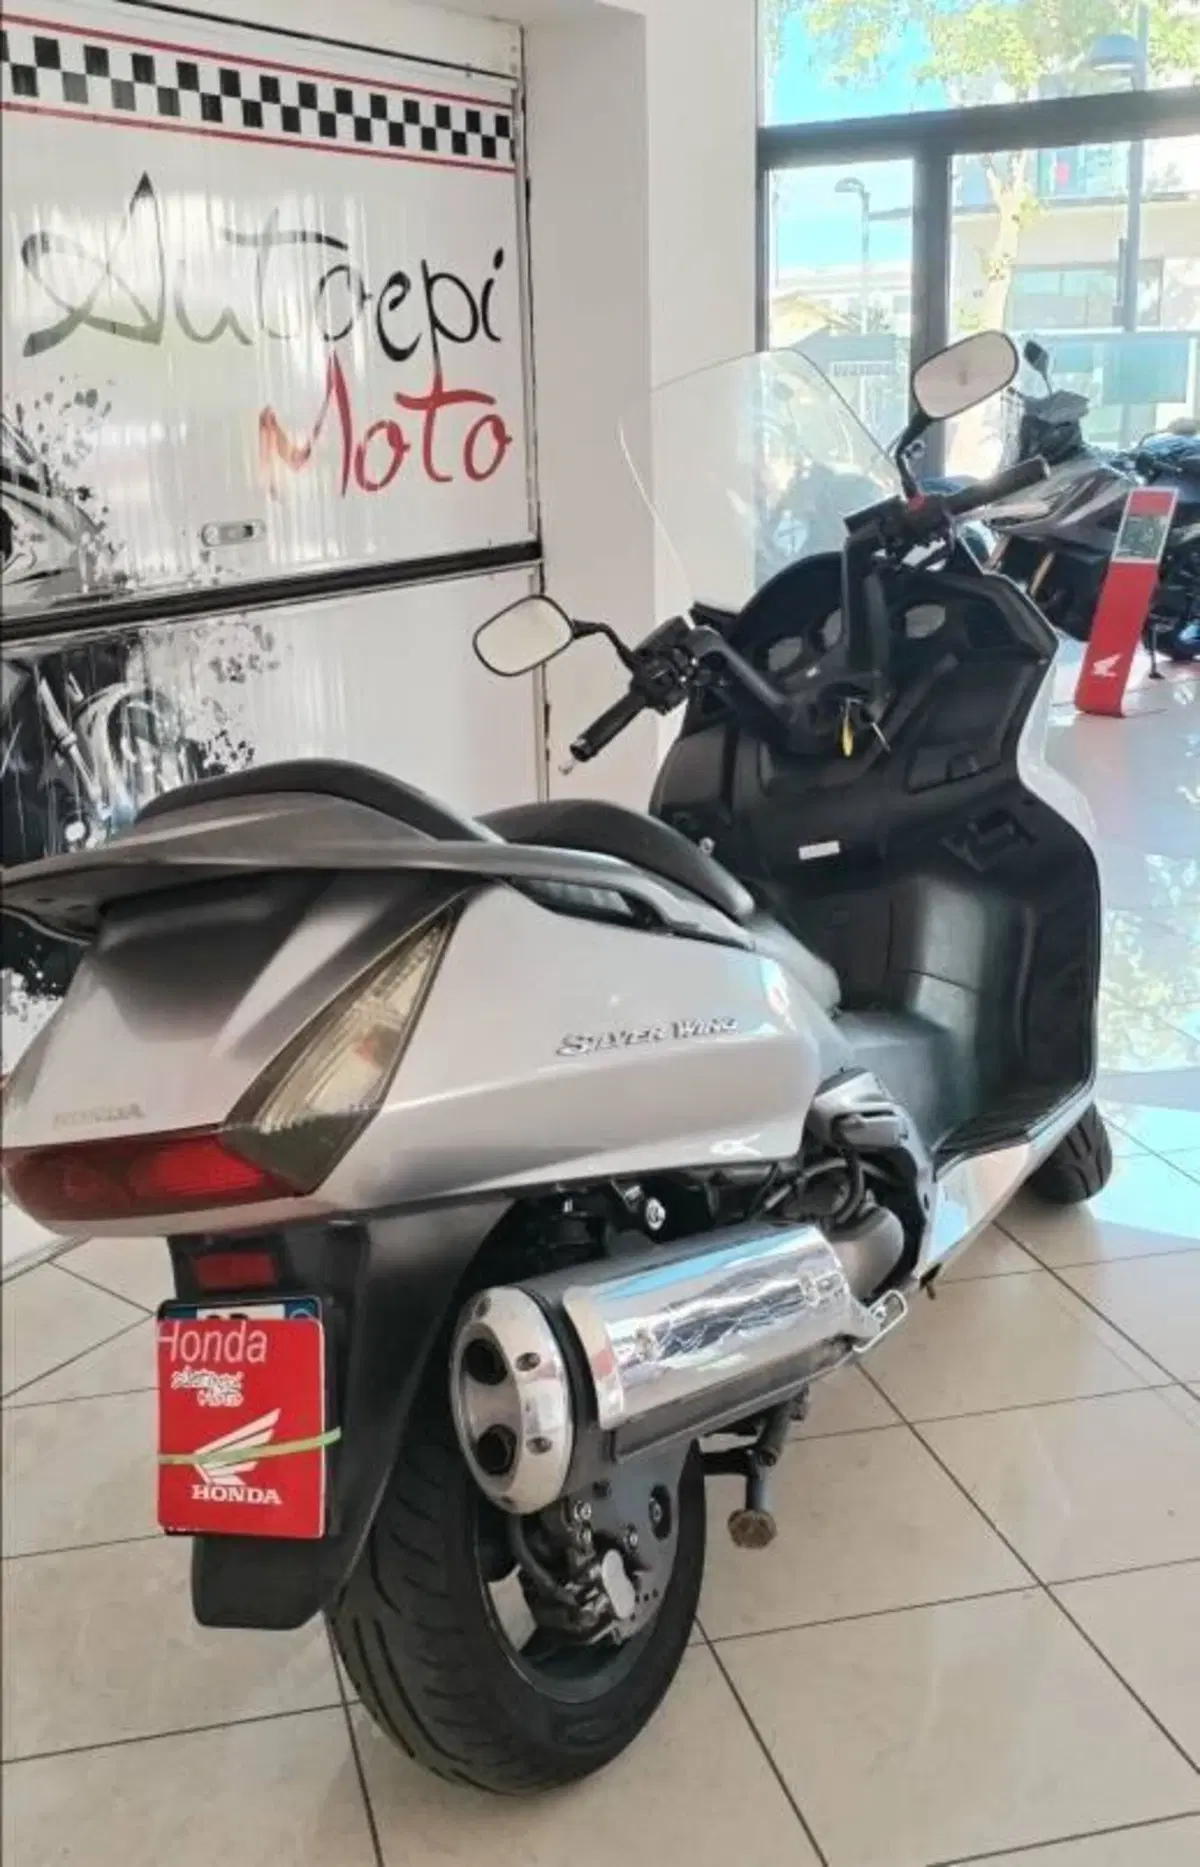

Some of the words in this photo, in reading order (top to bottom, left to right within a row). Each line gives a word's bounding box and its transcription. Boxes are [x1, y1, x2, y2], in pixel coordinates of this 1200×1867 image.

[259, 350, 512, 497] Moto
[158, 1319, 268, 1364] Honda
[191, 1483, 284, 1505] HONDA
